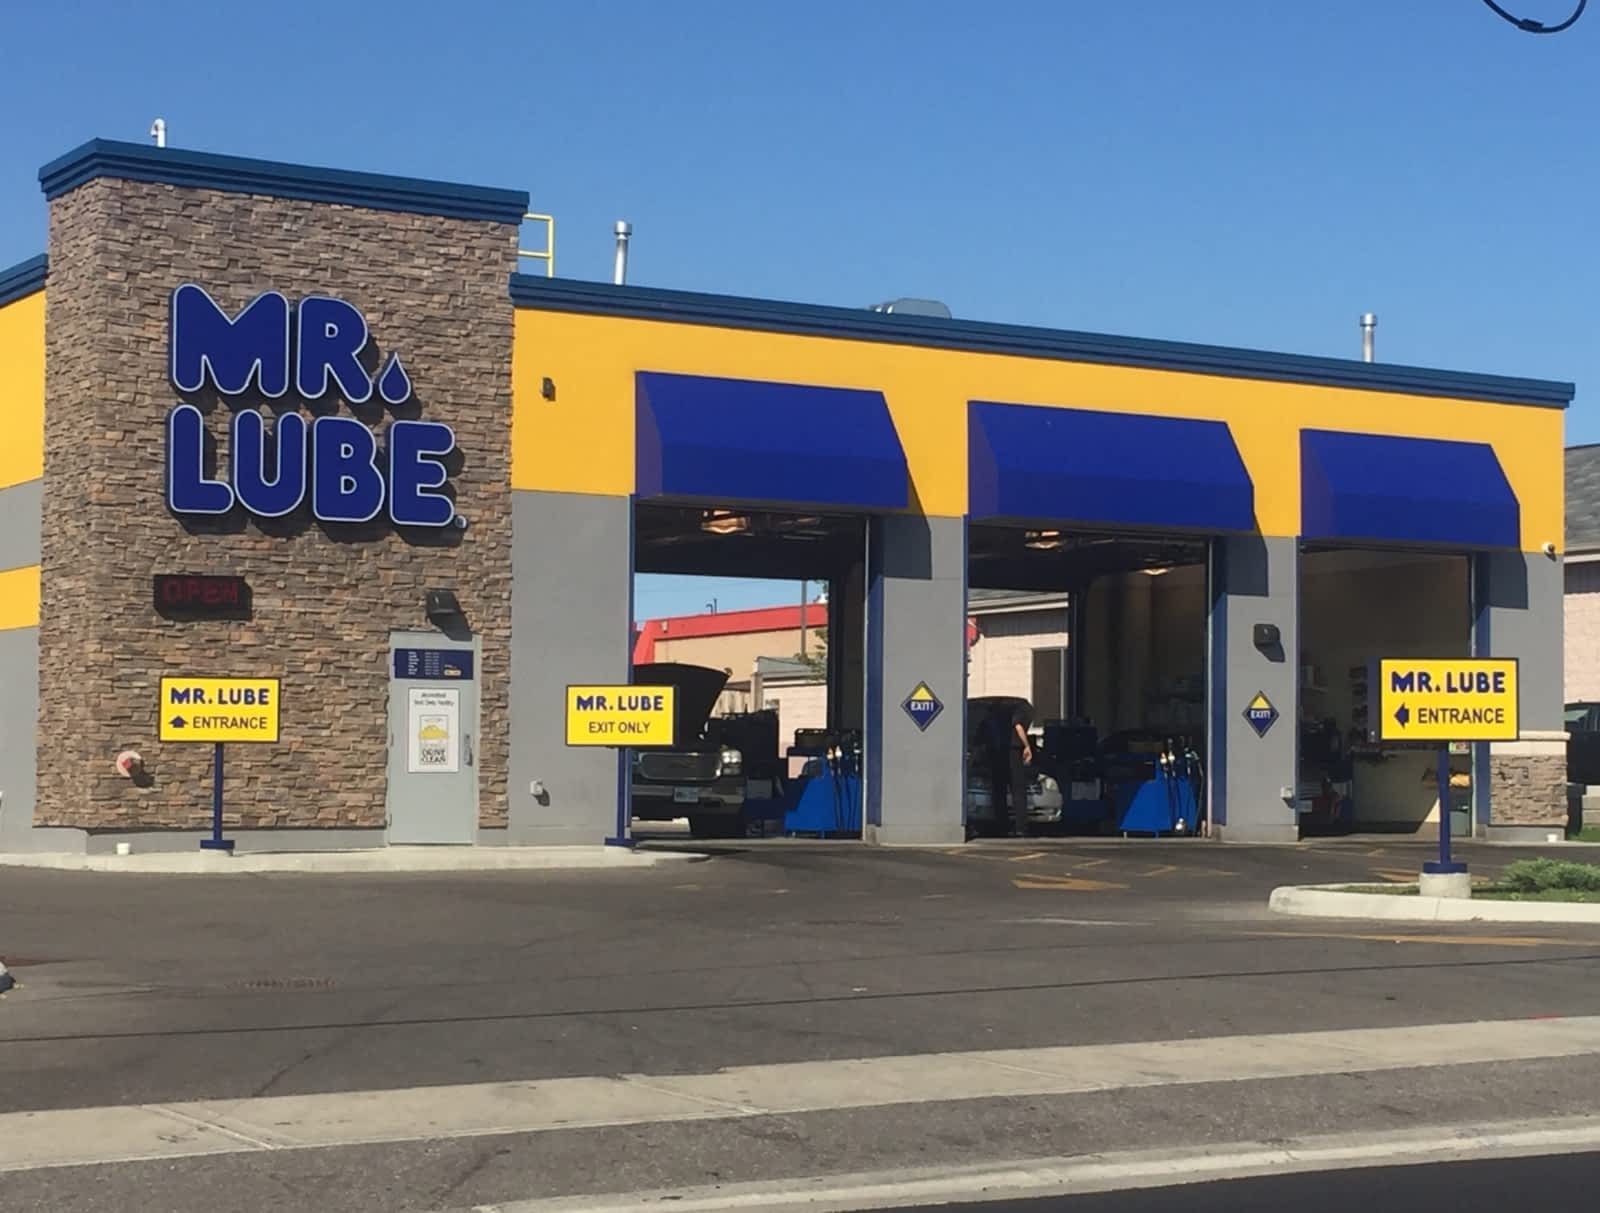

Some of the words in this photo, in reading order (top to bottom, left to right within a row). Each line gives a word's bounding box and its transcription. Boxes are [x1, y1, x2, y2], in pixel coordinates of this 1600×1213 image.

[172, 283, 412, 404] MR.
[169, 403, 455, 527] LUBE
[162, 579, 238, 604] OPEN
[1391, 671, 1441, 693] MR.
[1446, 671, 1506, 693] LUBE
[171, 687, 213, 704] MR.
[218, 688, 270, 705] LUBE
[576, 695, 614, 711] MR.
[618, 695, 664, 711] LUBE
[192, 716, 268, 729] ENTRANCE
[1418, 708, 1505, 724] ENTRANCE
[588, 721, 615, 733] EXIT
[618, 721, 650, 733] ONLY
